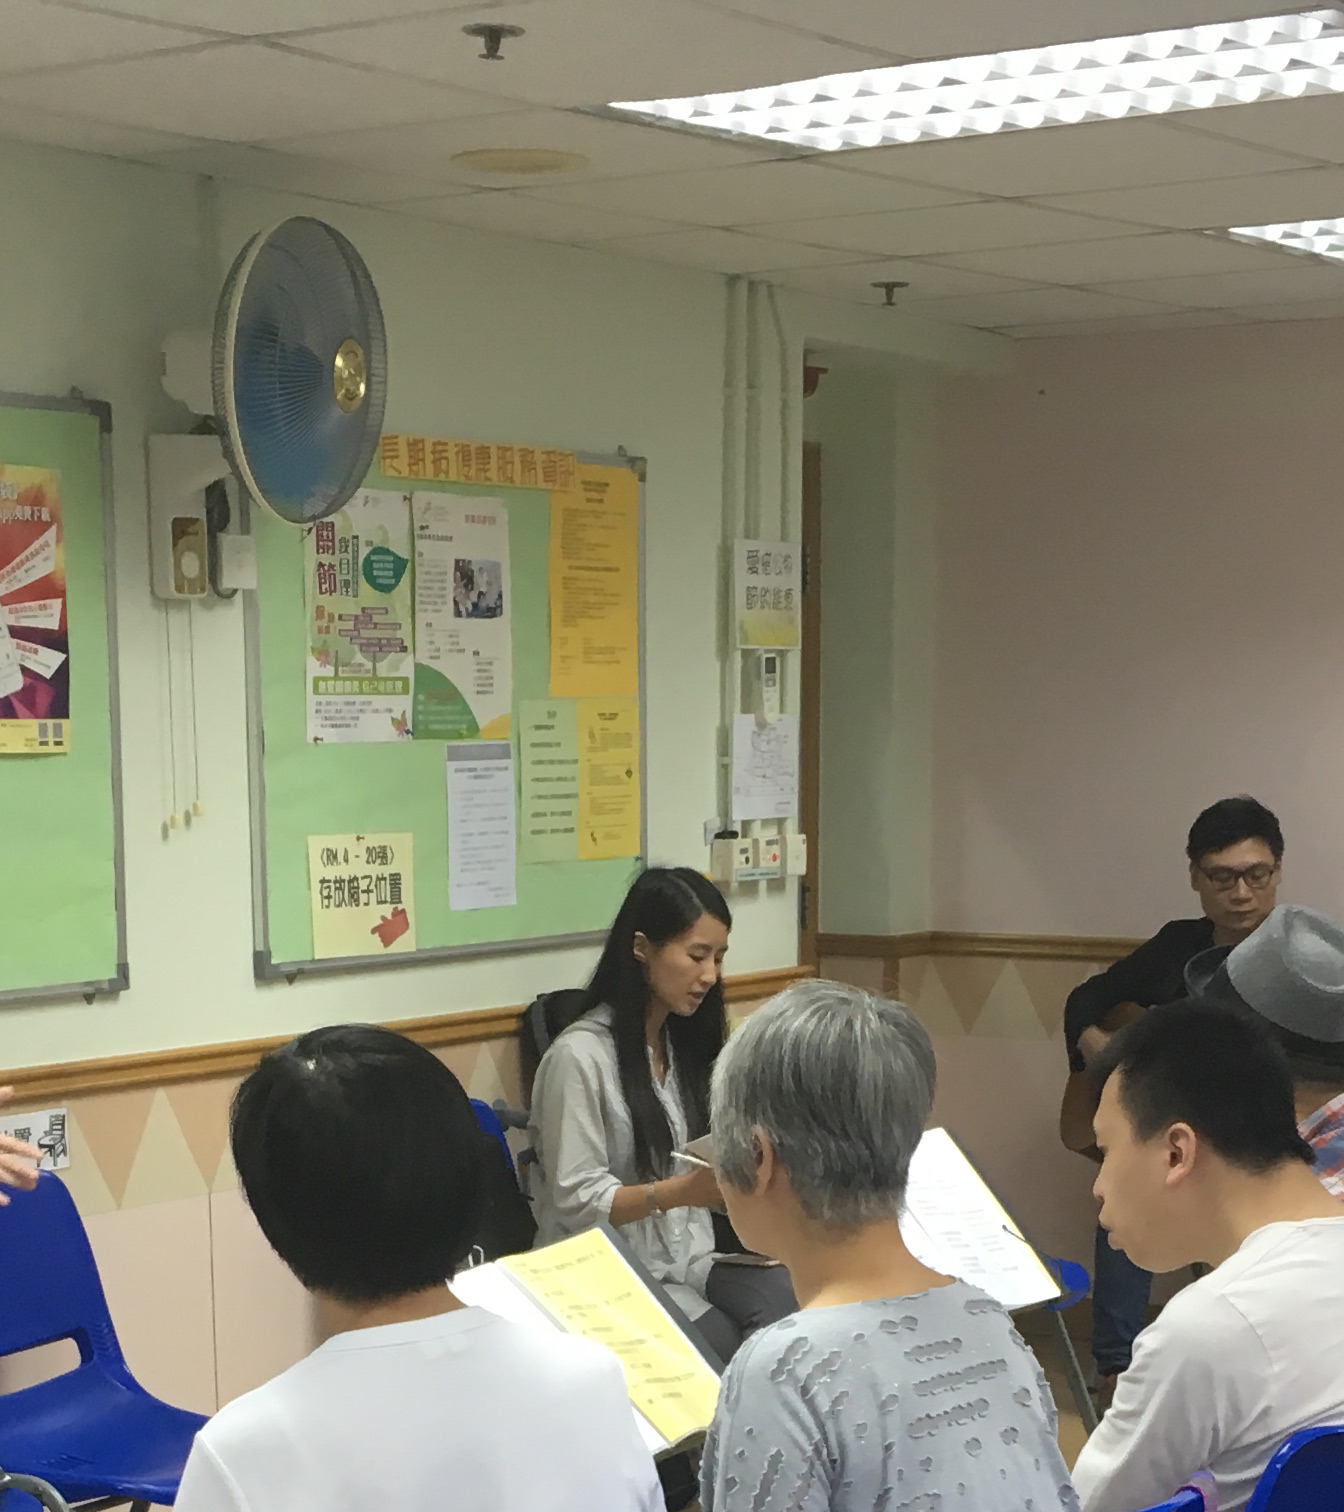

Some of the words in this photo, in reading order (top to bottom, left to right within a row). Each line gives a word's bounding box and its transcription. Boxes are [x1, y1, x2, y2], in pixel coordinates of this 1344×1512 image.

[319, 873, 402, 909] 存放椅子位置
